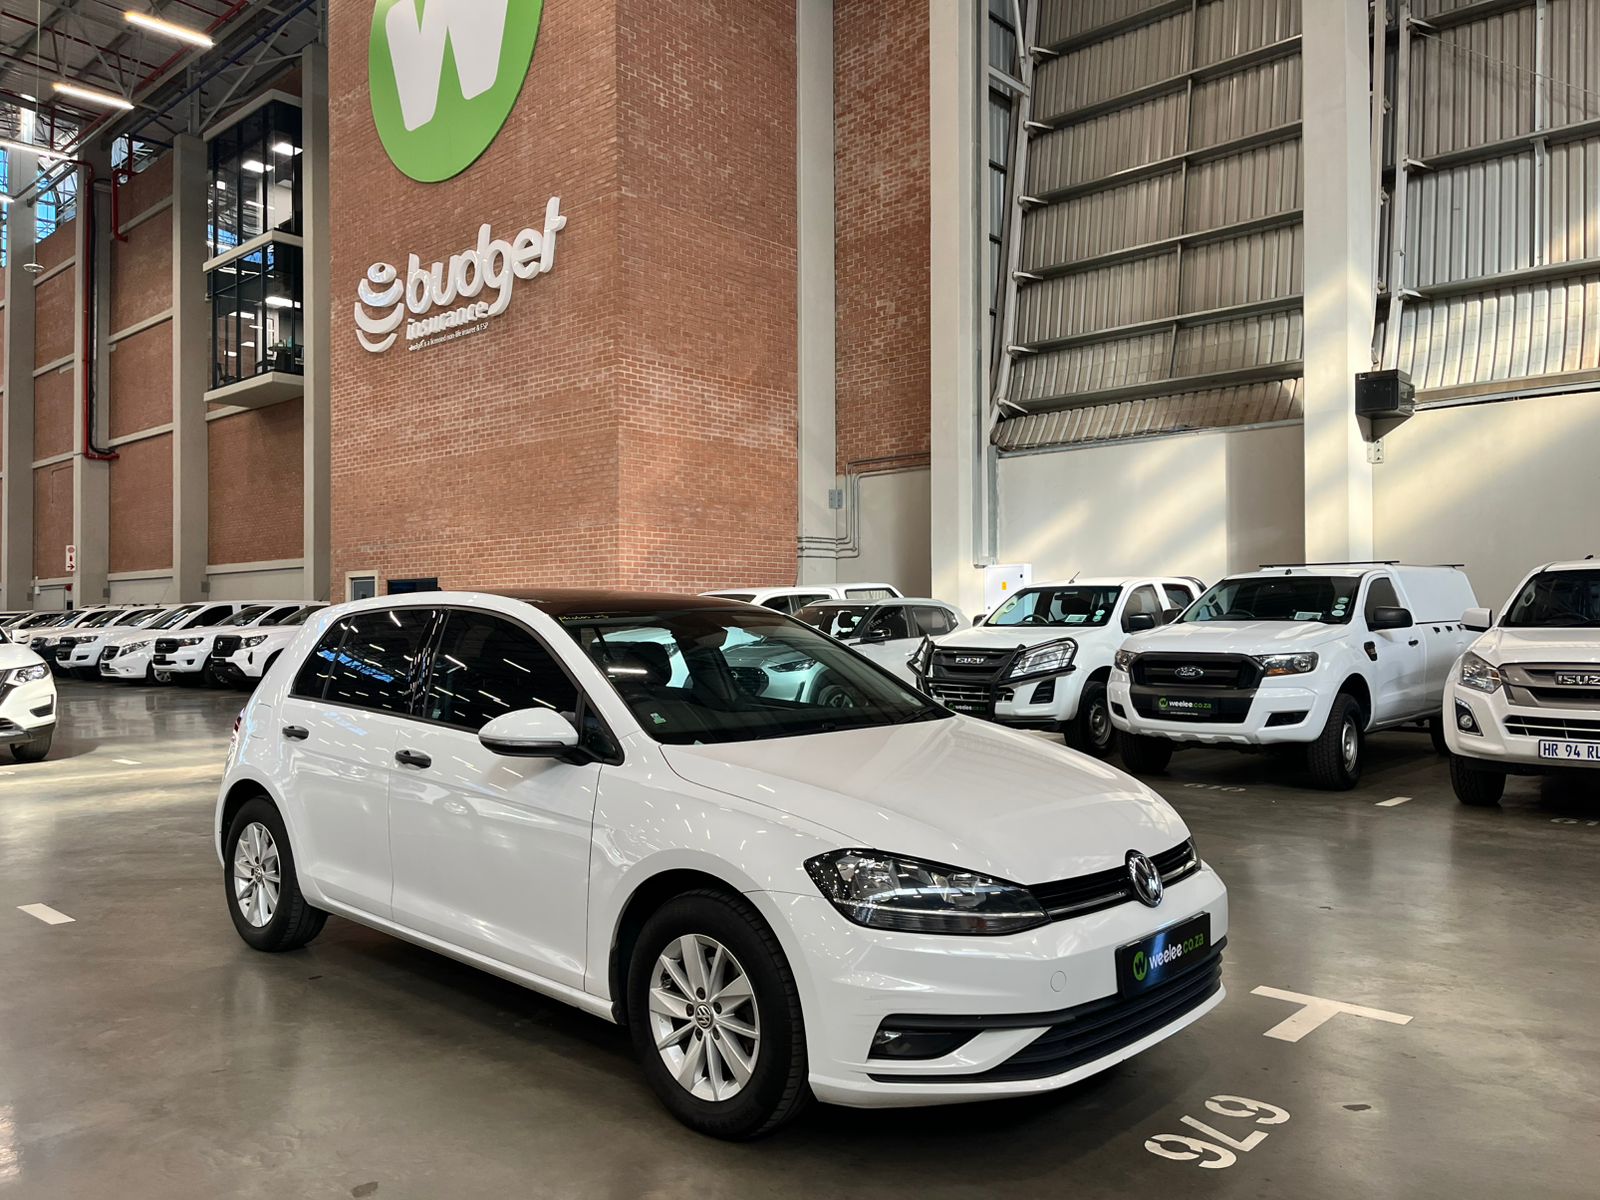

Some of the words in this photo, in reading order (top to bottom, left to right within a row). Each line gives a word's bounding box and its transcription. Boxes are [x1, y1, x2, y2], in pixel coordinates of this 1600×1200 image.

[406, 196, 567, 316] budget
[406, 301, 489, 340] insurance
[955, 657, 985, 665] ISUZU
[1543, 742, 1558, 757] HR
[1565, 744, 1581, 759] 94
